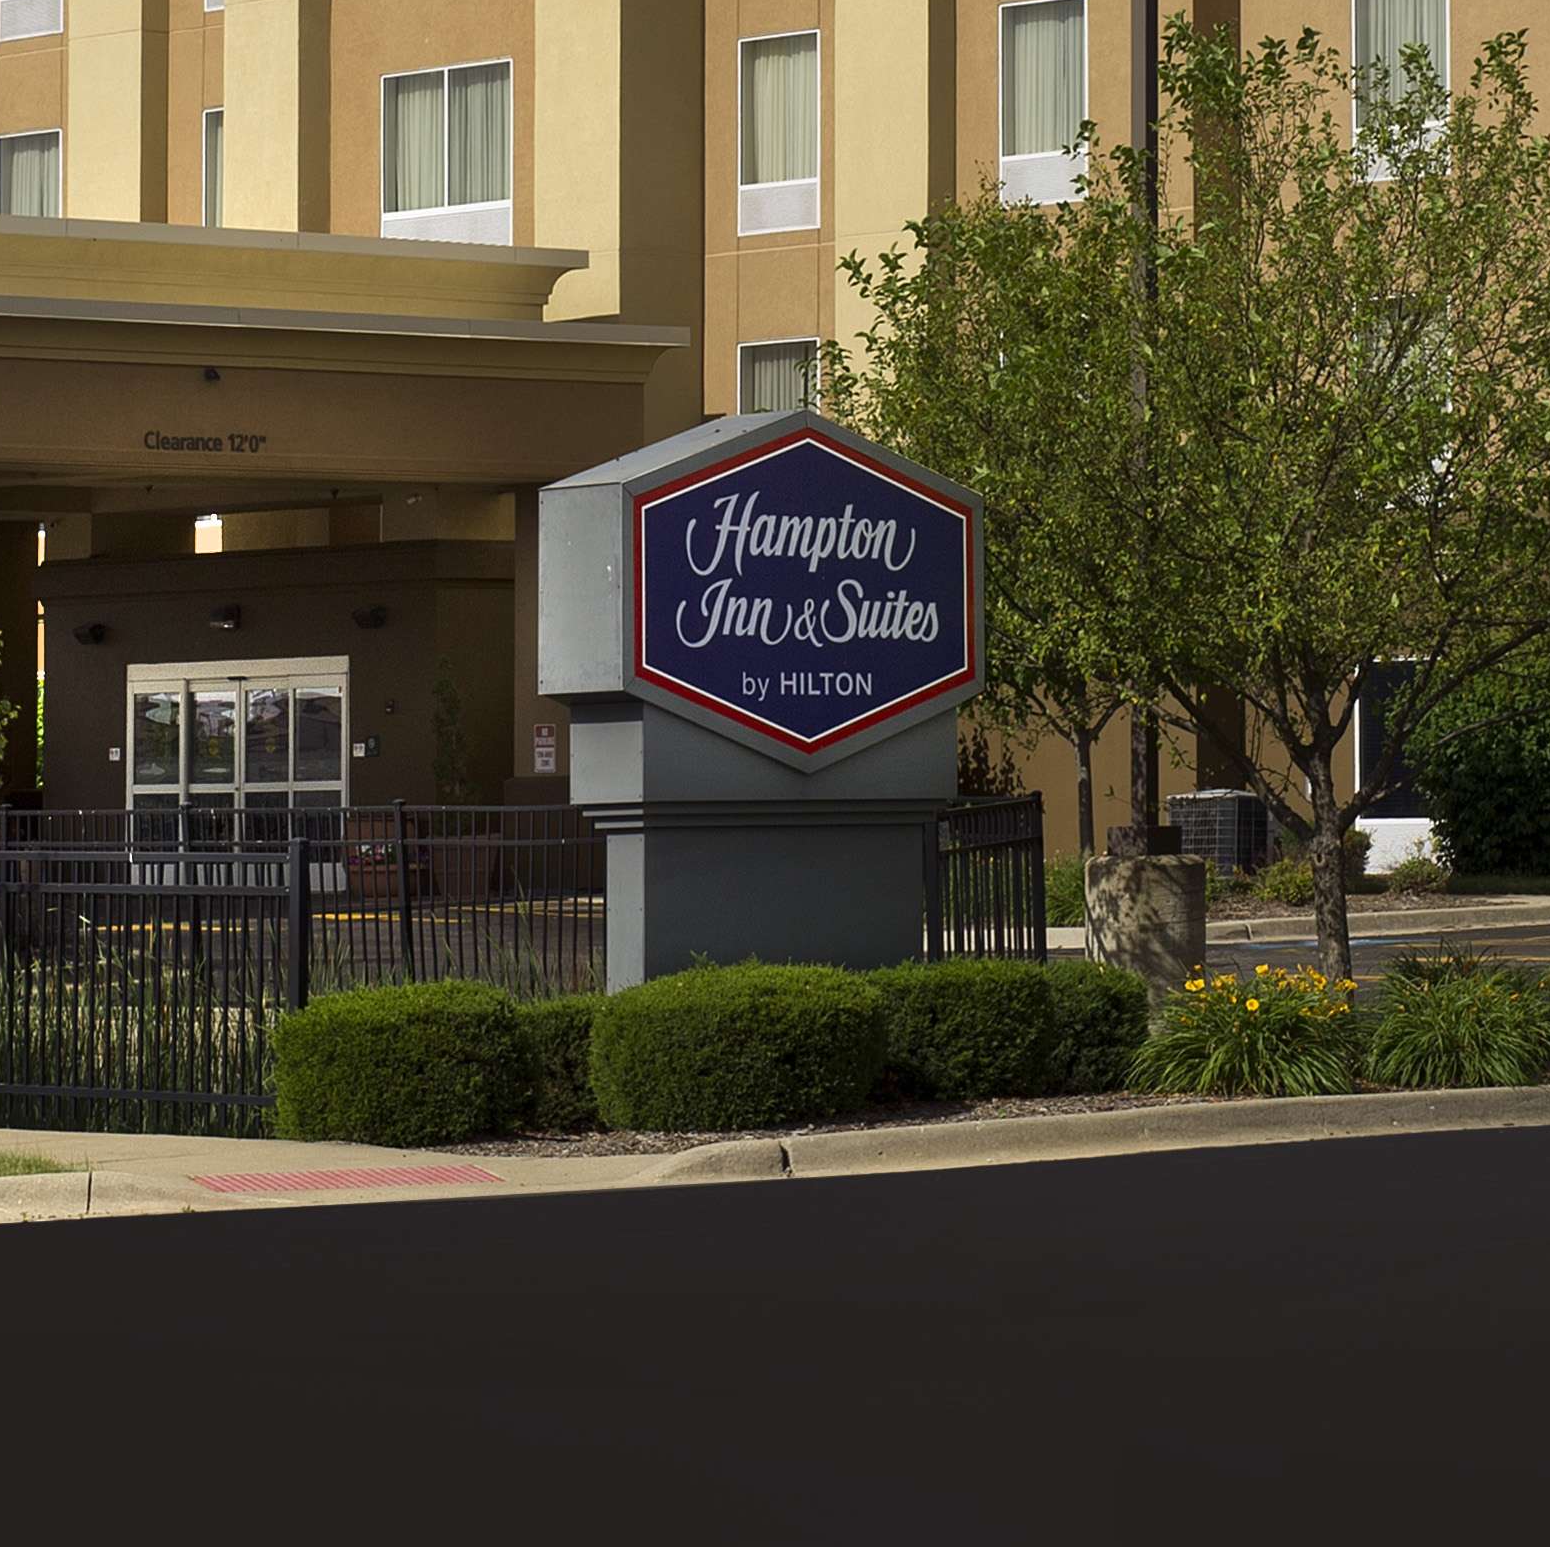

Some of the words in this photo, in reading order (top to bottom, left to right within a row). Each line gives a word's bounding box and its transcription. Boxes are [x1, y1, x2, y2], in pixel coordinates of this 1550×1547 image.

[144, 431, 224, 452] Clearance
[686, 490, 916, 577] Hampton
[676, 578, 792, 648] Inn
[793, 598, 824, 647] &
[820, 579, 939, 643] Suites
[742, 671, 770, 702] by
[779, 672, 873, 696] HILTON
